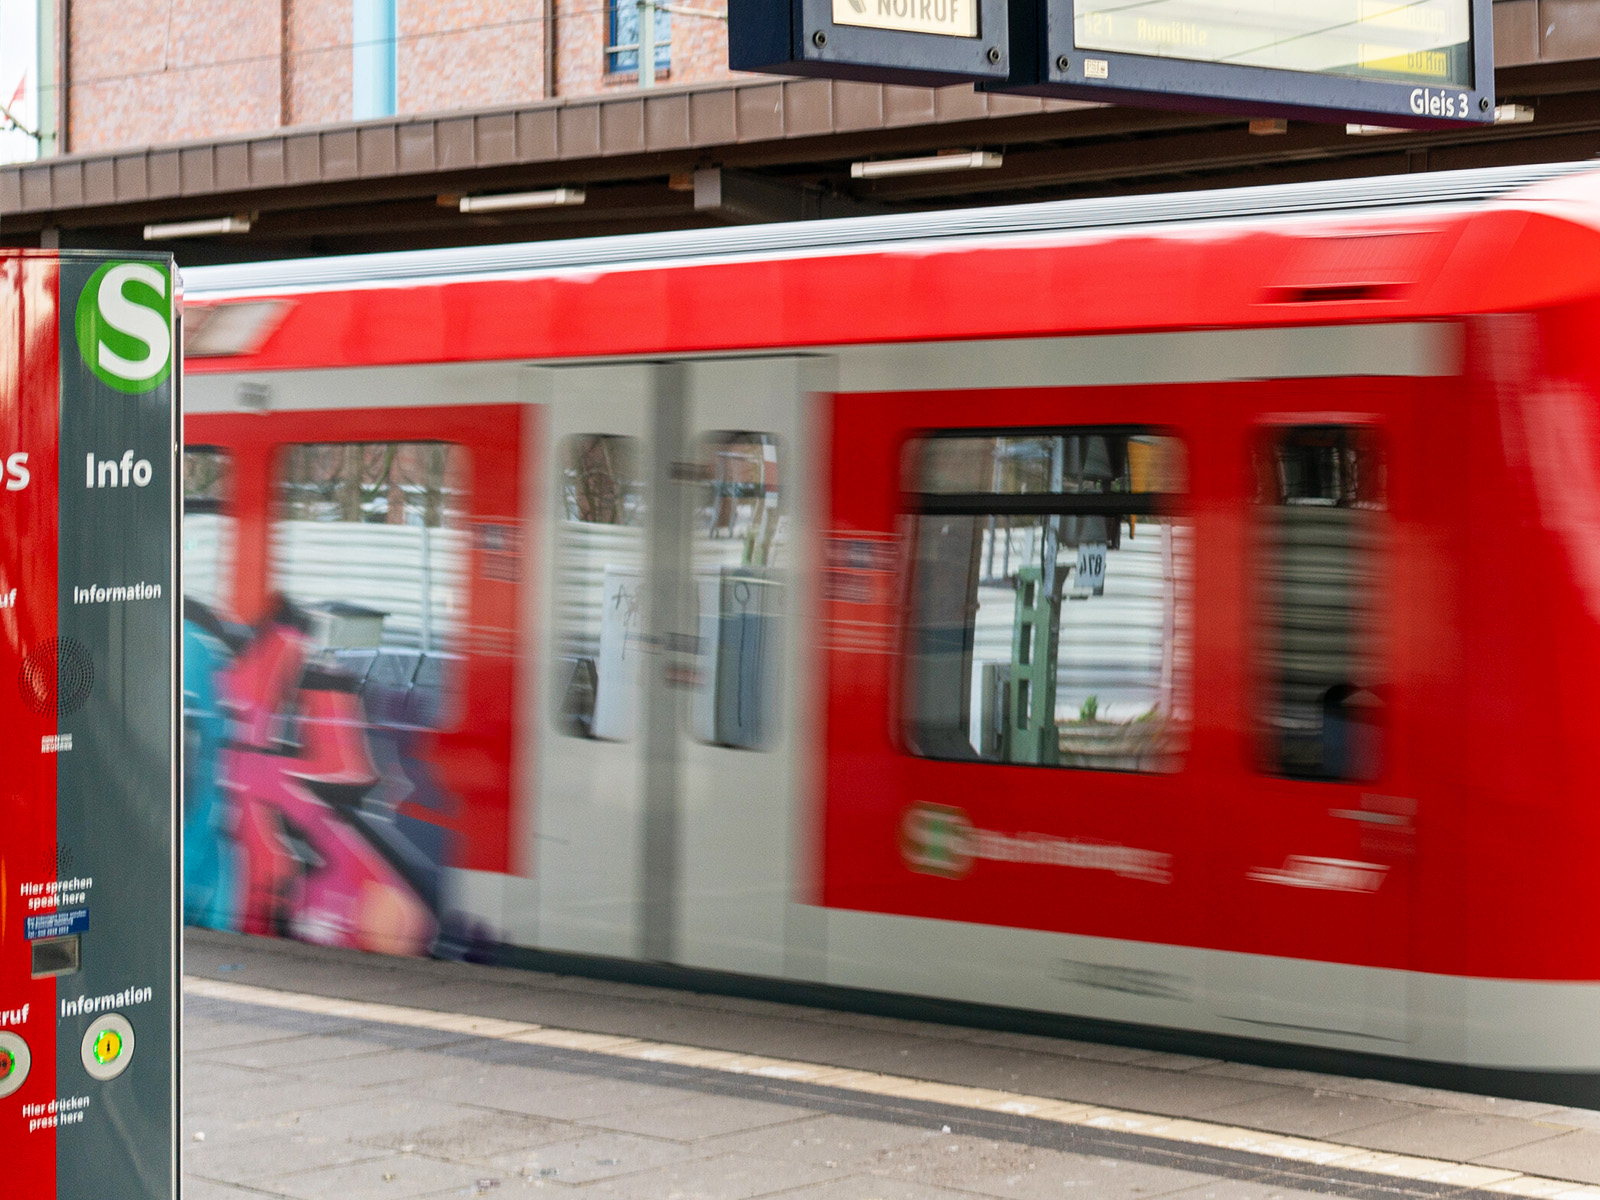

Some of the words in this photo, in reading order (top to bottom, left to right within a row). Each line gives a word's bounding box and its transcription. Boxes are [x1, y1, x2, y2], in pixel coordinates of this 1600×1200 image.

[1137, 17, 1207, 46] Aumühle
[1410, 88, 1455, 117] Gleis
[1458, 93, 1469, 118] 3
[98, 263, 171, 381] S
[86, 450, 153, 489] Info
[73, 581, 162, 605] Information
[20, 881, 44, 896] Hier
[45, 876, 93, 896] sprechen
[28, 893, 61, 911] speak
[62, 891, 86, 905] here
[61, 985, 153, 1017] Information
[22, 1103, 46, 1119] Hier
[47, 1094, 90, 1115] drücken
[29, 1117, 58, 1134] press
[60, 1110, 84, 1124] here
